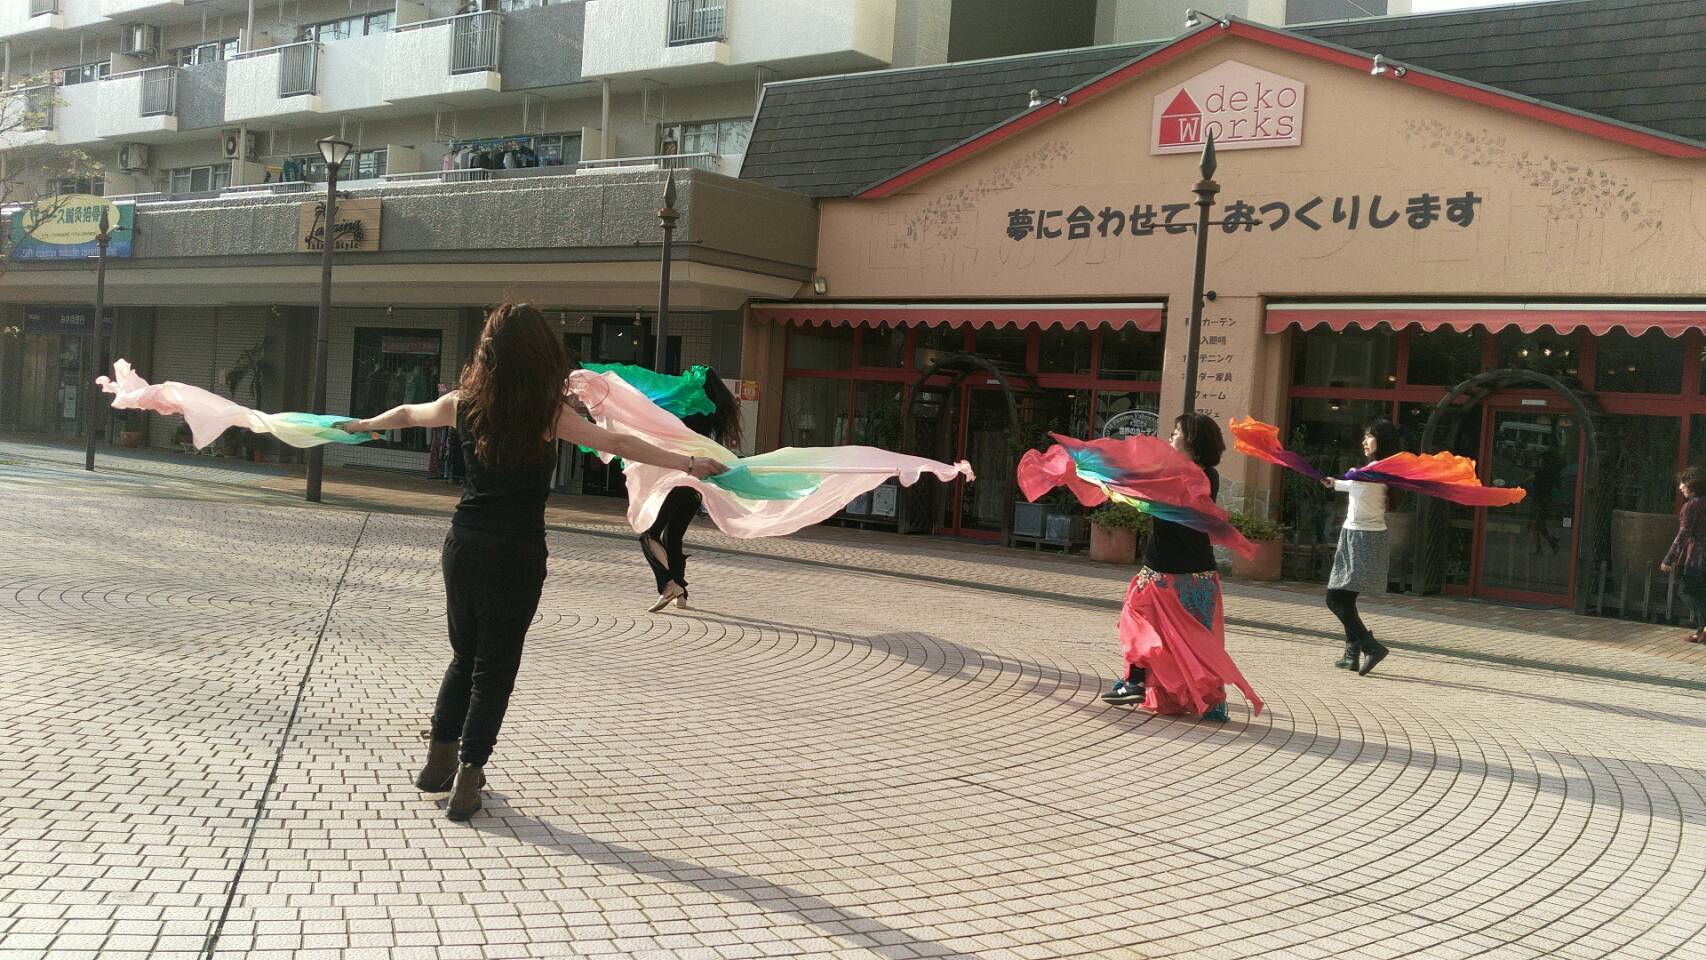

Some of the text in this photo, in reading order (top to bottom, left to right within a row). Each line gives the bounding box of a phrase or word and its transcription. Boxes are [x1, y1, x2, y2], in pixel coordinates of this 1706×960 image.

[1206, 82, 1297, 114] deko
[1178, 110, 1294, 142] Works
[1185, 317, 1236, 327] カーテン
[1199, 335, 1227, 346] 入照明
[1195, 390, 1226, 400] フォーム
